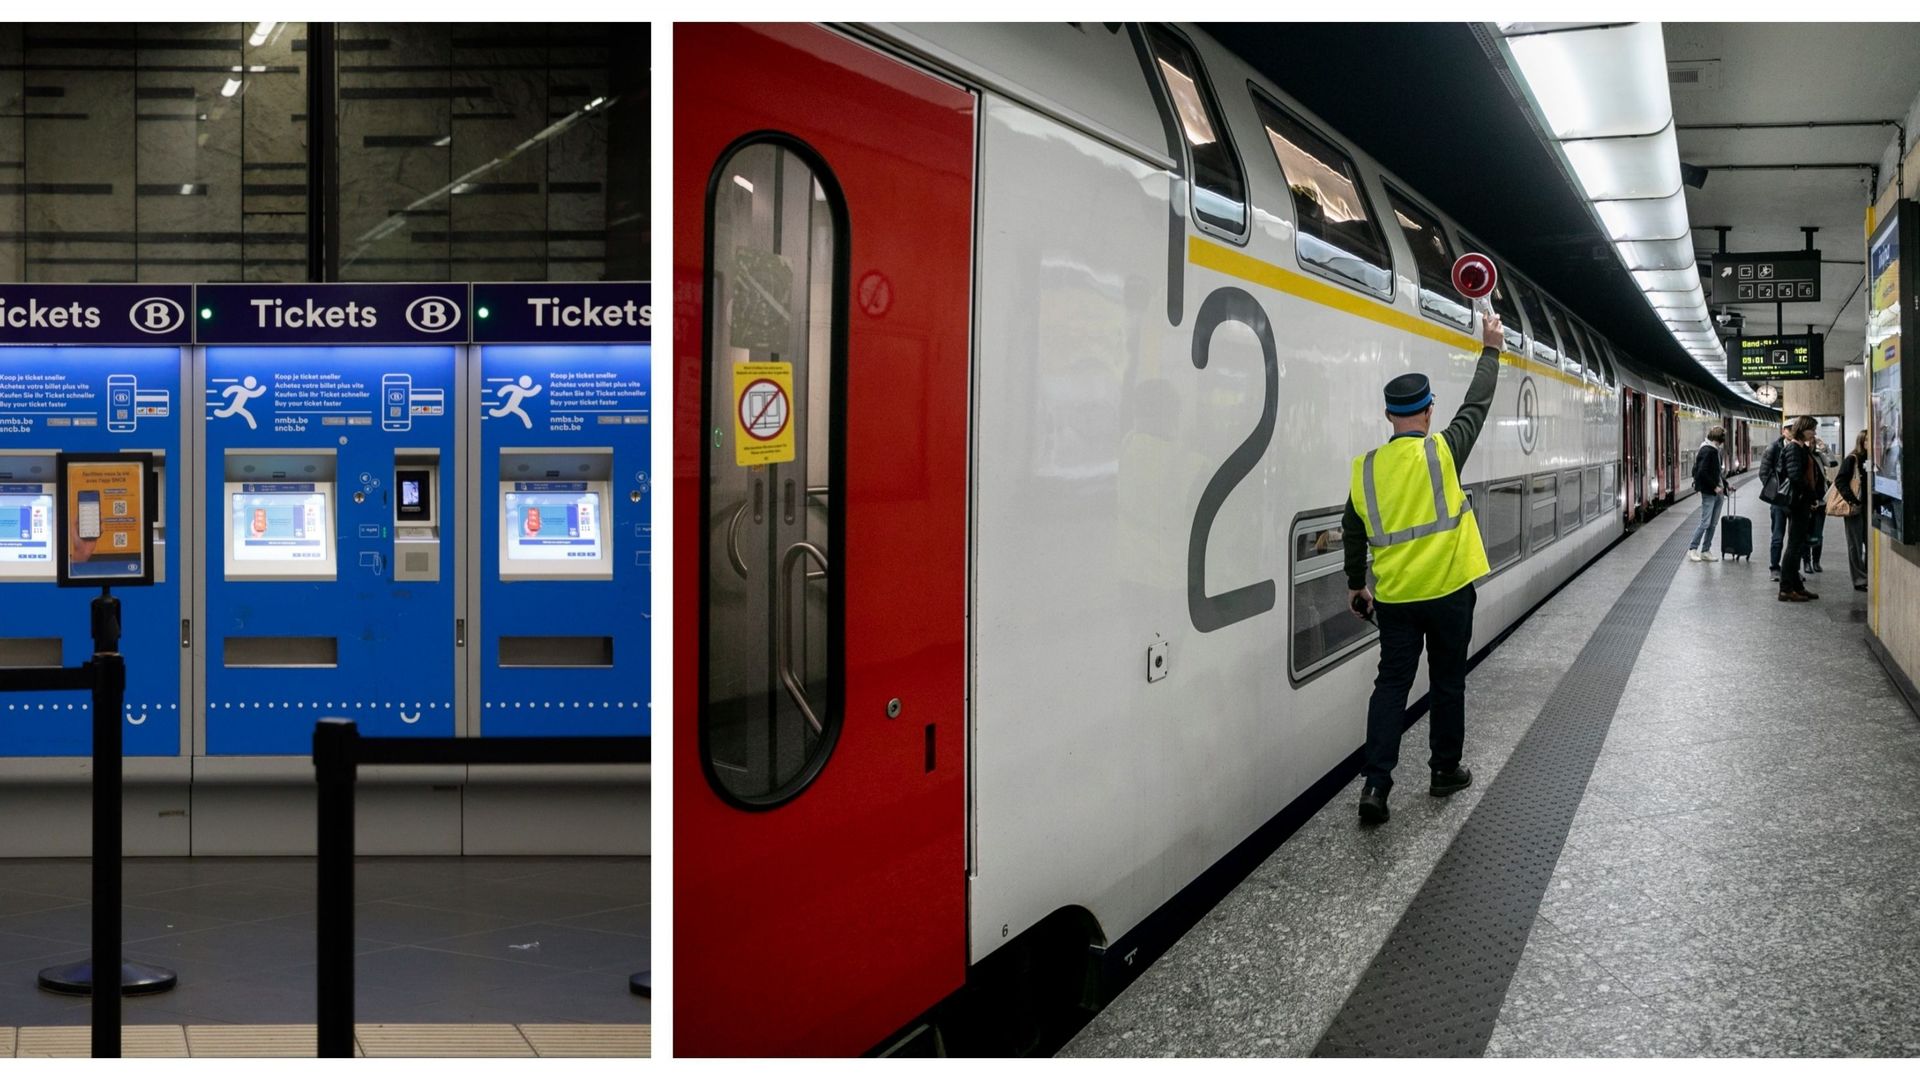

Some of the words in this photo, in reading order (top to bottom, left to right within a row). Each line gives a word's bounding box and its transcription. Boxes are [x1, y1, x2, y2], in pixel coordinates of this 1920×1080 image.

[250, 298, 377, 329] Tickets
[527, 296, 651, 328] Tickets
[1187, 286, 1279, 634] 2
[1001, 924, 1008, 938] 6
